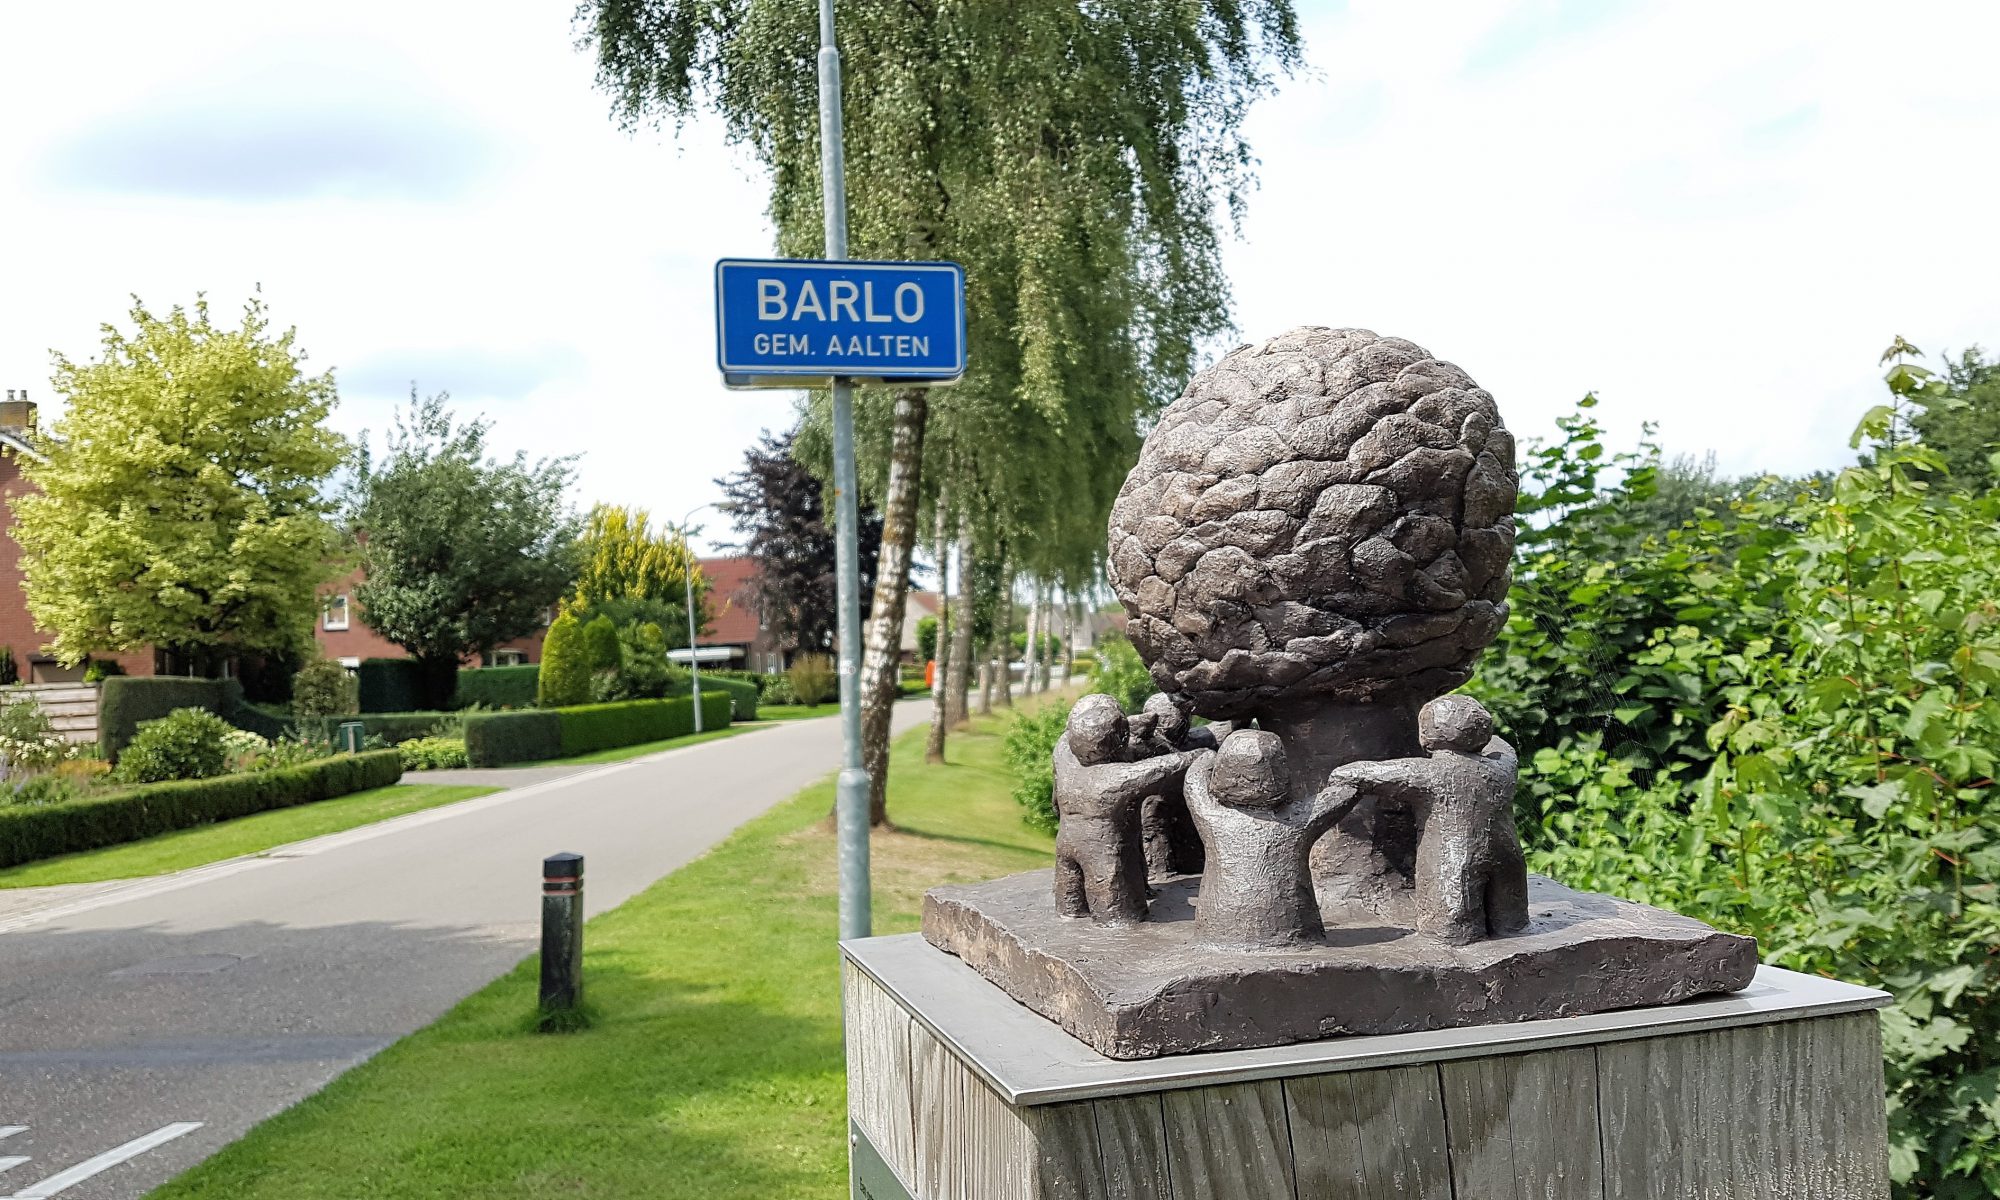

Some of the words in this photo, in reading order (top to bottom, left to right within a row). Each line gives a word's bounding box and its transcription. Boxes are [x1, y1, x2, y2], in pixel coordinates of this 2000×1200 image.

[757, 278, 926, 324] BARLO
[753, 333, 816, 356] GEM.
[826, 334, 930, 357] AALTEN
